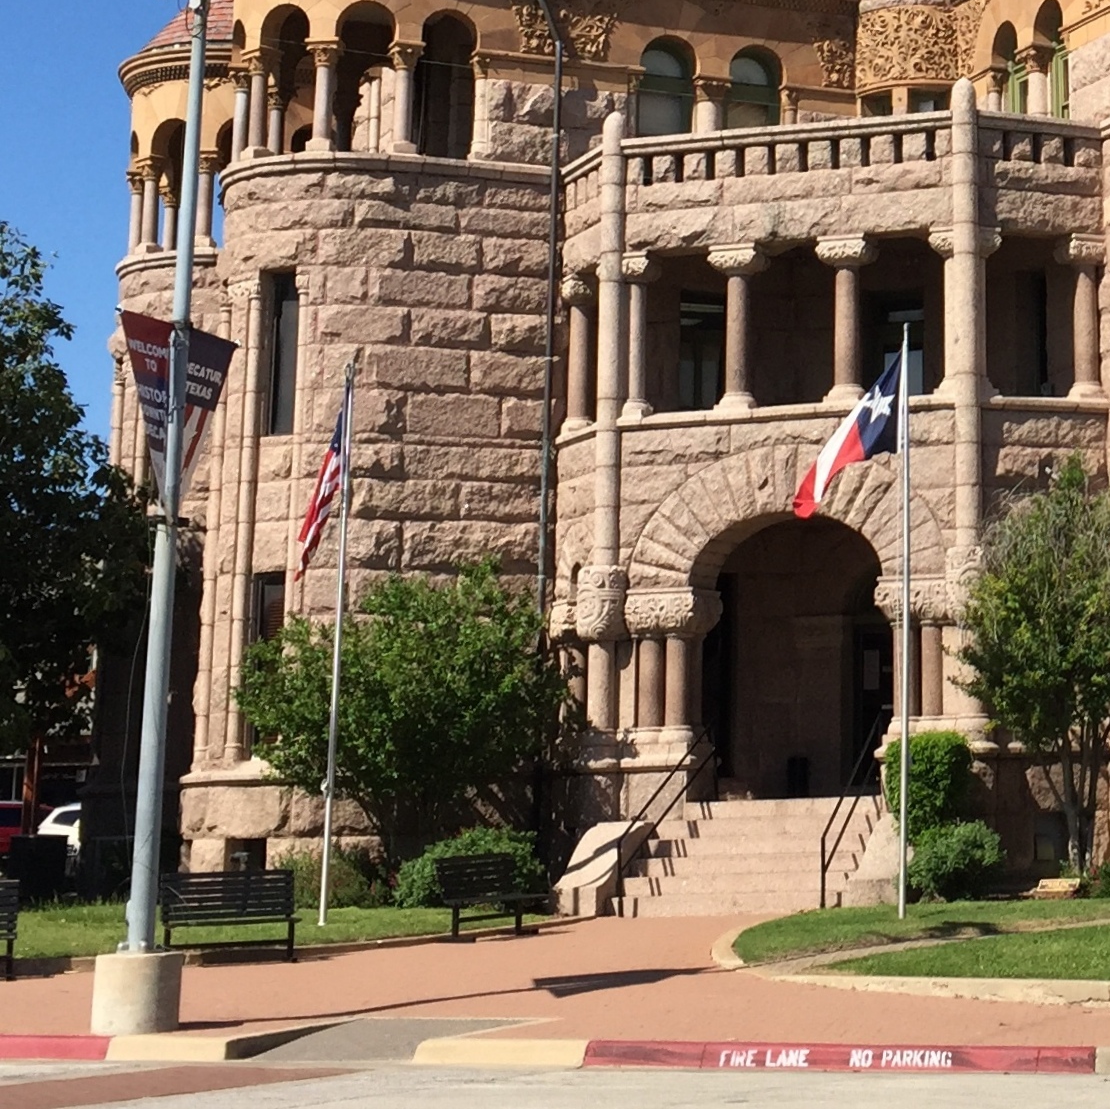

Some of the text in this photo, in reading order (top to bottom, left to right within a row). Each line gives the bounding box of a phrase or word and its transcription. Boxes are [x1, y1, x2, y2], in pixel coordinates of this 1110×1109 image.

[144, 358, 157, 372] TO
[187, 362, 222, 386] ECATUR,
[185, 381, 213, 400] TEXAS
[719, 1049, 953, 1068] FIRE LANE NO PARKING
